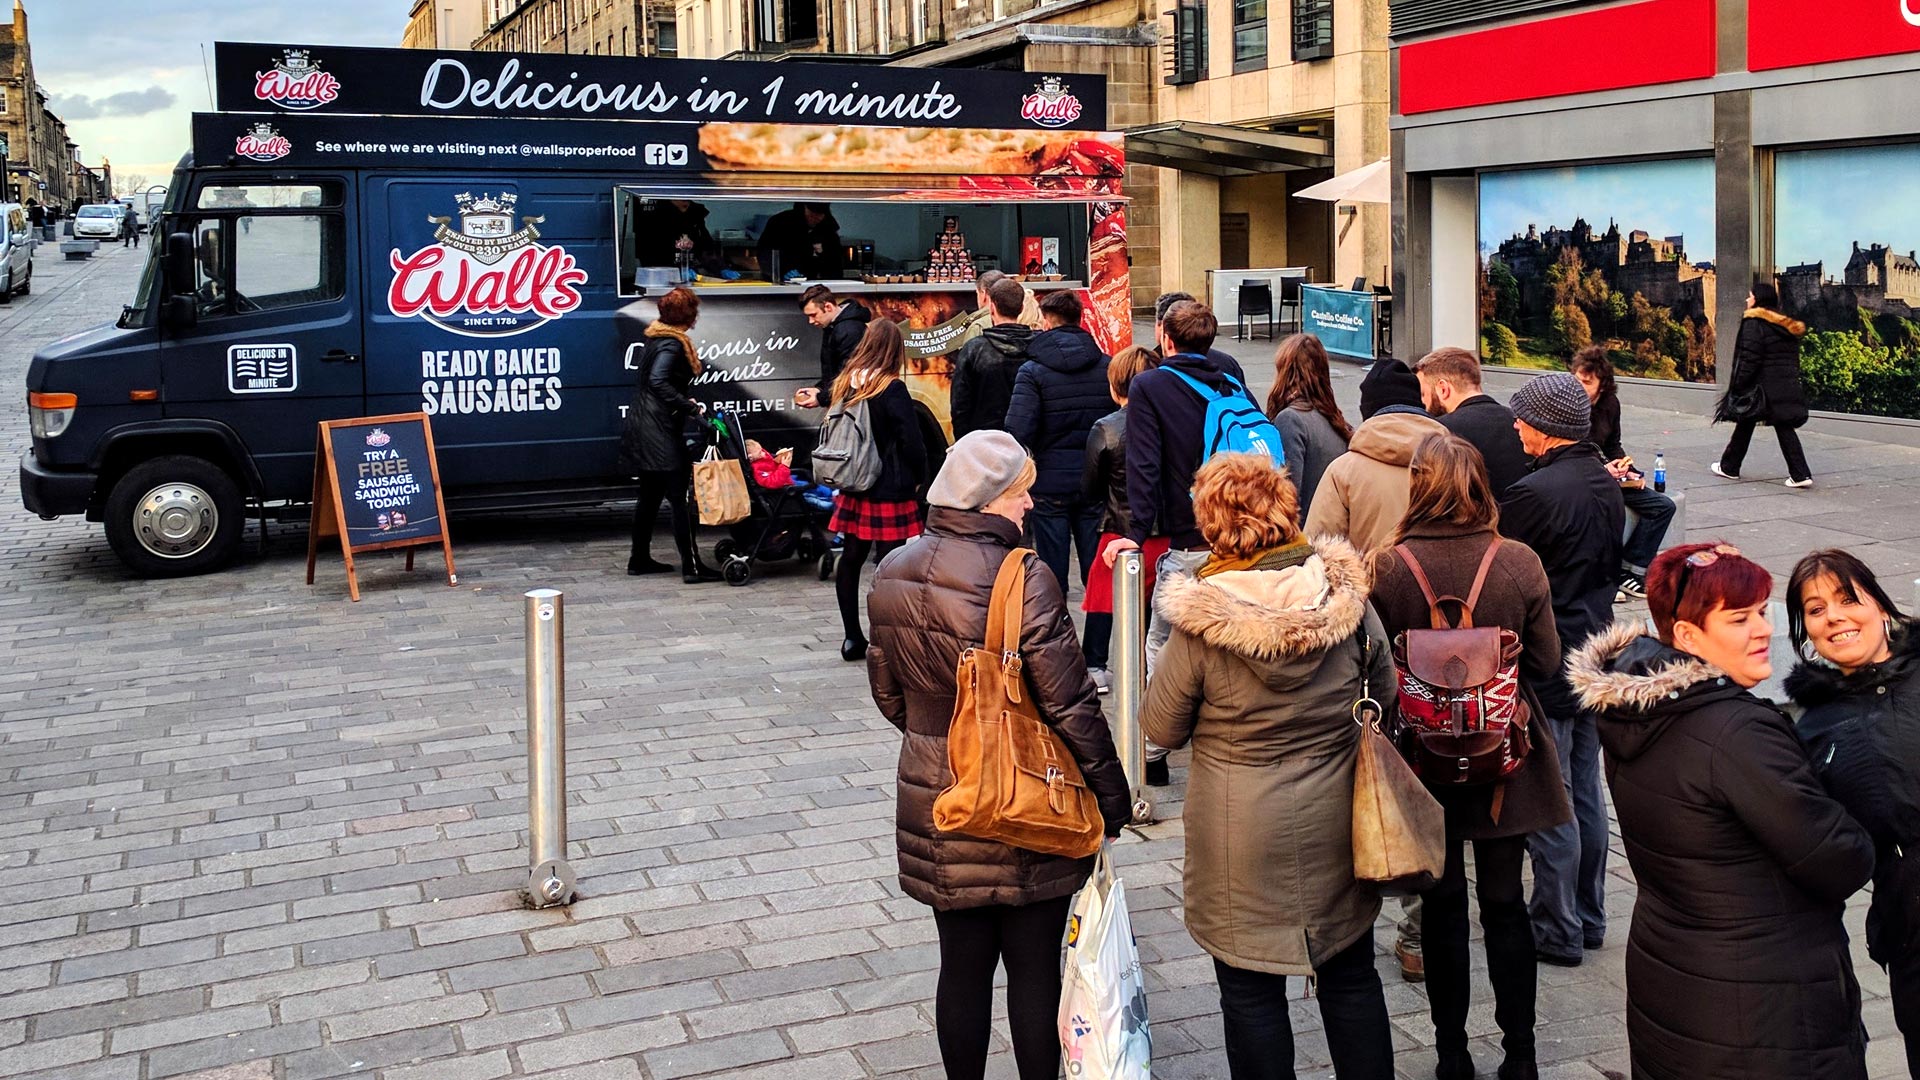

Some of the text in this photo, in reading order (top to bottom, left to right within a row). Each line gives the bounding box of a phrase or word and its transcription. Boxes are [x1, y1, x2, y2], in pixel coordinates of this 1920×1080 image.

[255, 71, 340, 103] Wall's
[420, 58, 962, 119] Delicious in 1 minute
[1021, 93, 1082, 122] Wall's
[236, 136, 292, 157] Wall's
[315, 141, 636, 157] See where we are visiting next @wallsproperfood
[445, 229, 482, 245] ENJOYED
[497, 228, 530, 245] BRITAIN
[453, 240, 475, 252] OVER
[476, 245, 500, 257] 230
[501, 236, 530, 251] YEARS
[390, 246, 587, 318] Wall's
[464, 317, 517, 326] SINCE 1786
[933, 325, 953, 337] FREE
[764, 330, 799, 351] in
[904, 326, 966, 347] USAGE SANDWIC
[920, 343, 947, 354] TODAY
[260, 359, 266, 378] 1
[422, 348, 561, 378] READY BAKED
[421, 377, 562, 415] SAUSAGES
[713, 398, 785, 413] BELIEVE
[363, 449, 399, 461] TRY A
[358, 459, 410, 478] FREE
[358, 474, 414, 489] SAUSAGE
[354, 484, 420, 500] SANDWICH
[367, 496, 411, 510] TODAY!
